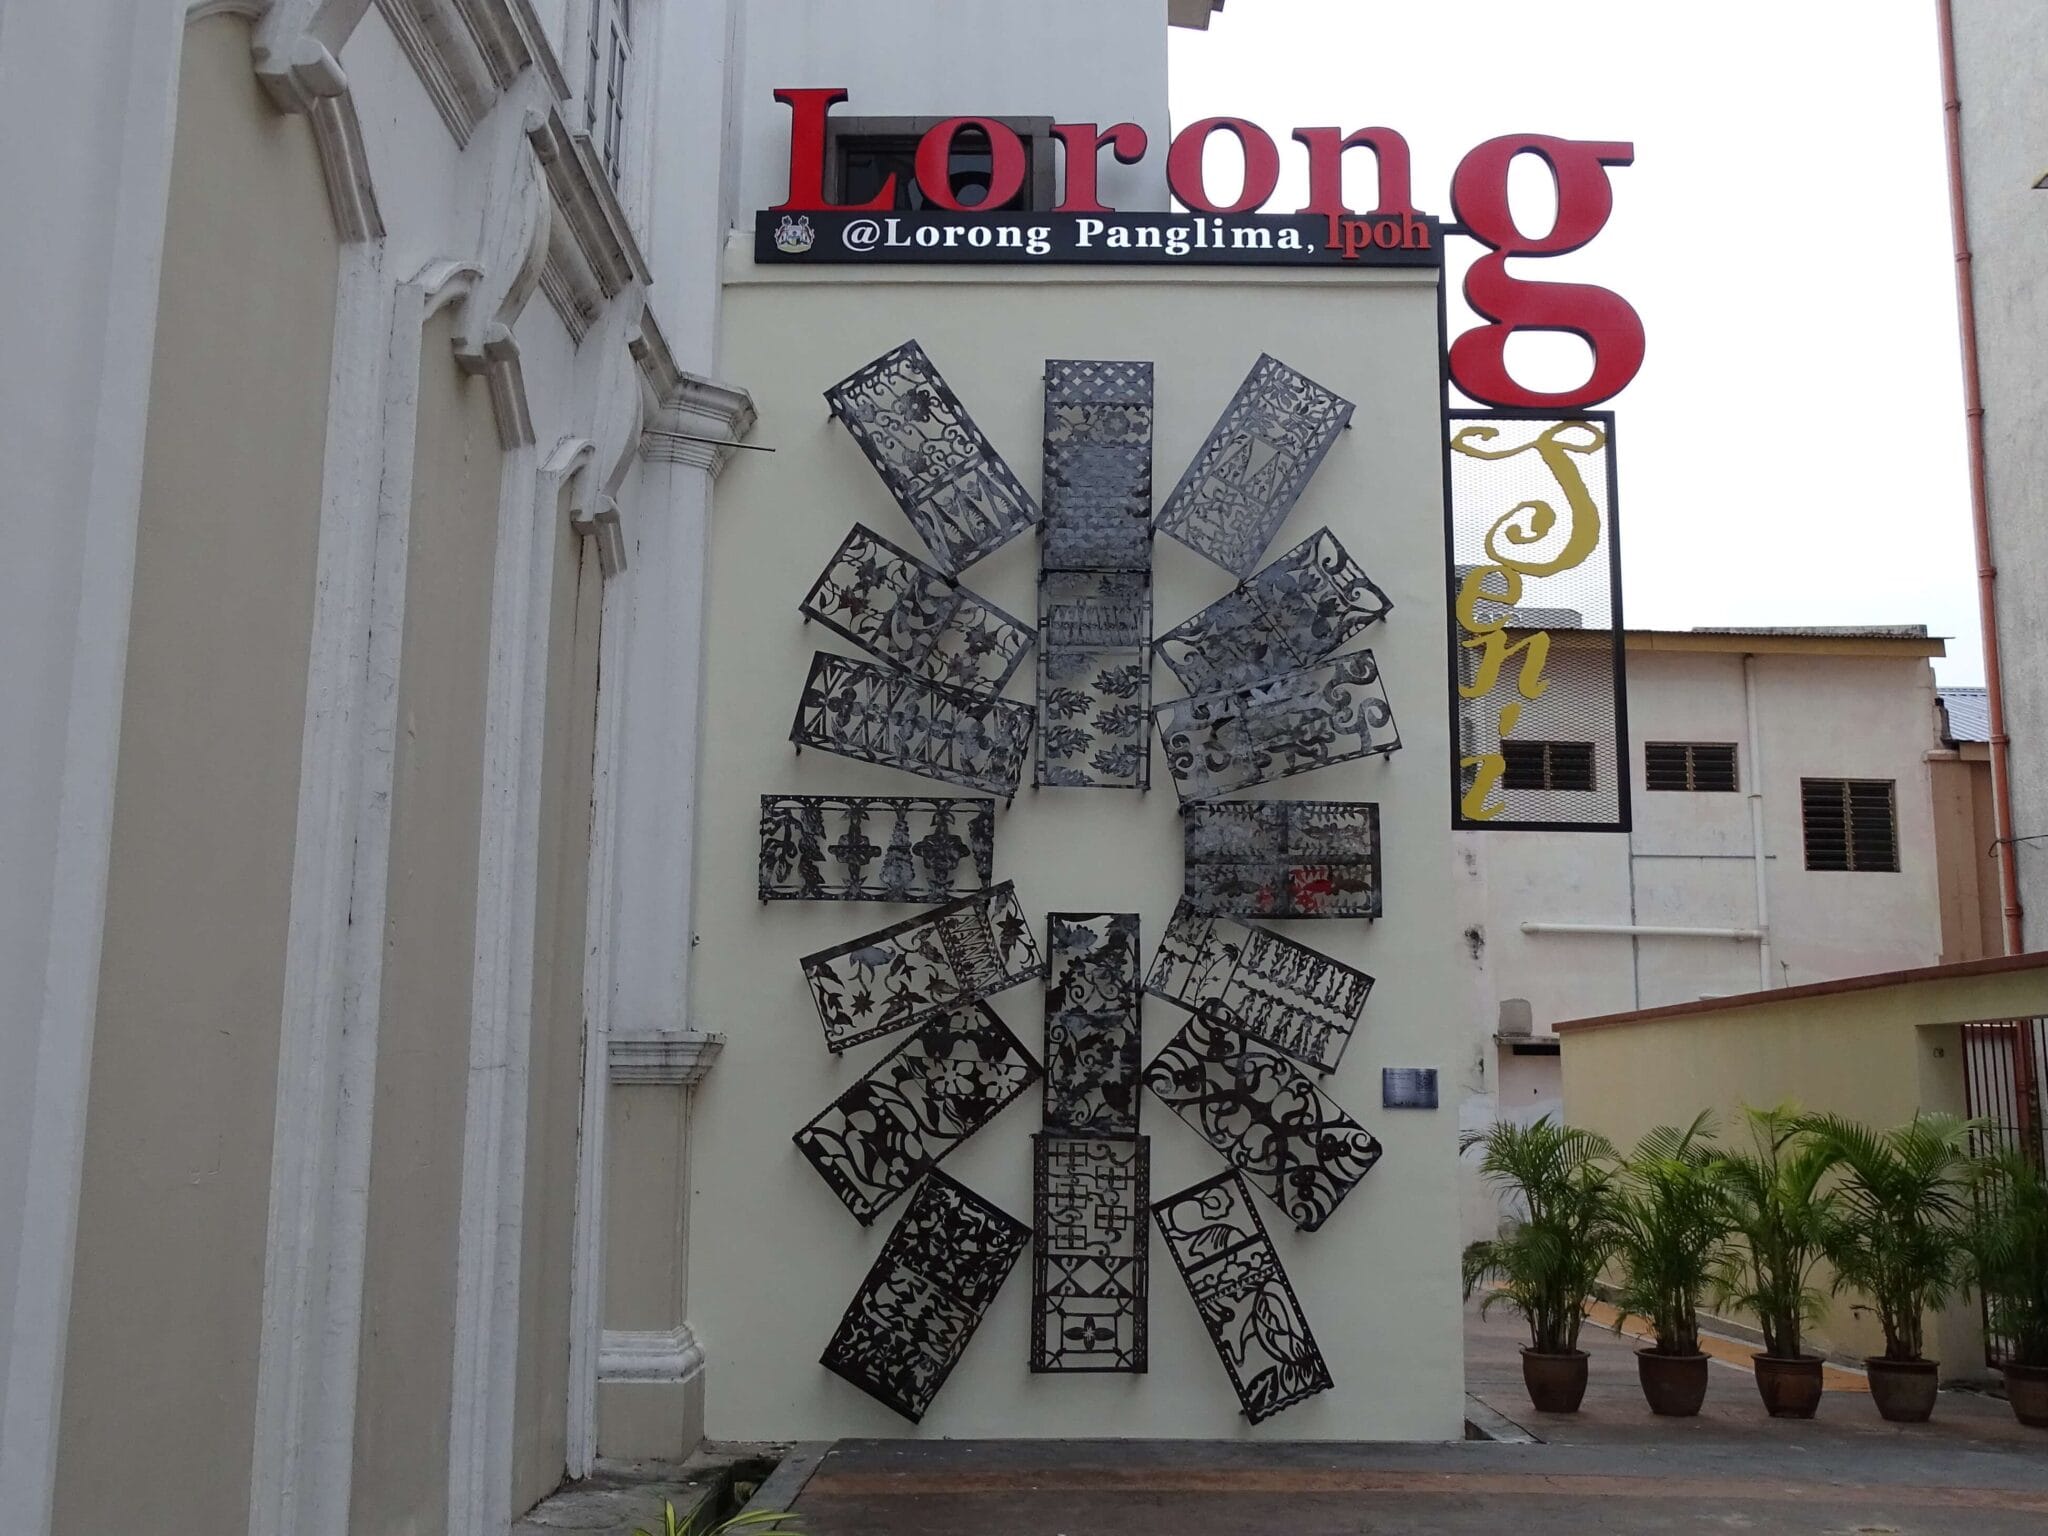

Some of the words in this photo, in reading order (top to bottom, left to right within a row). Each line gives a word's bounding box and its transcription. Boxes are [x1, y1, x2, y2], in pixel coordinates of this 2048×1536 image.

[768, 87, 1646, 409] Lorong
[841, 218, 1052, 255] @Lorong
[1075, 218, 1315, 256] Panglima,
[1324, 210, 1432, 260] Ipoh
[1450, 420, 1608, 822] Seni
